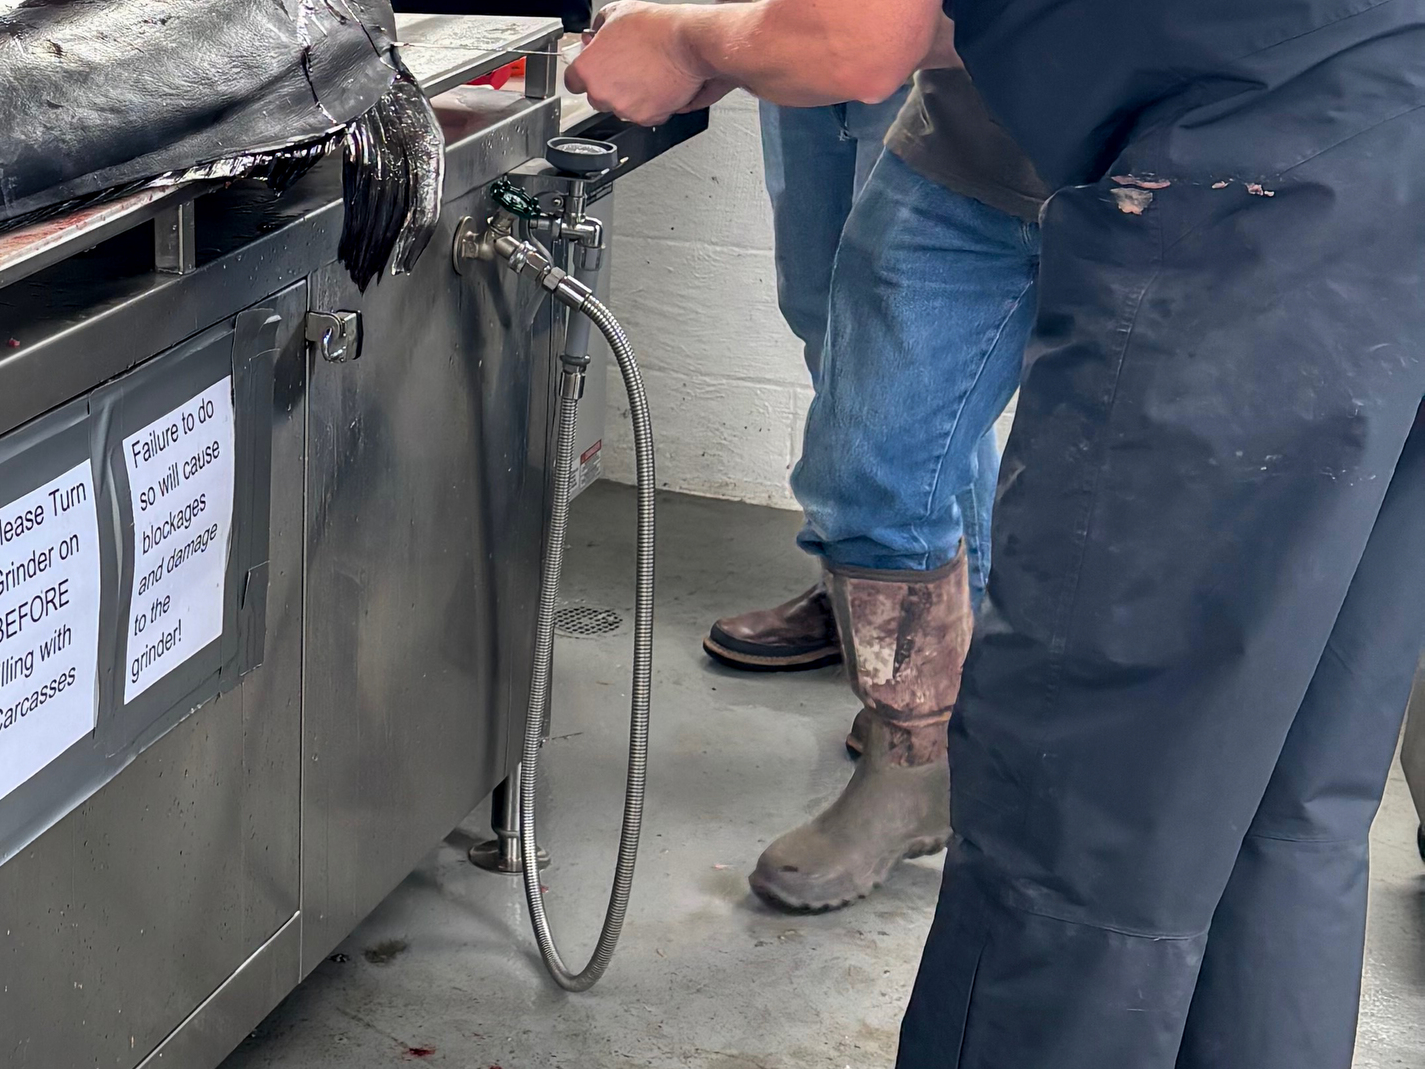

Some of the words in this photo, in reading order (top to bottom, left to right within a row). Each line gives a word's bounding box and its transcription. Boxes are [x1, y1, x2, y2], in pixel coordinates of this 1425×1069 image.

[131, 423, 179, 469] Failure
[181, 412, 195, 435] to
[198, 397, 214, 424] do
[48, 482, 87, 517] Turn
[139, 486, 156, 512] so
[158, 462, 180, 497] will
[183, 440, 220, 480] cause
[59, 534, 79, 561] on
[142, 493, 207, 556] blockages
[138, 556, 164, 596] and
[166, 523, 218, 574] damage
[39, 624, 72, 662] with
[134, 613, 147, 637] to
[150, 595, 171, 624] the
[131, 618, 182, 684] grinder!
